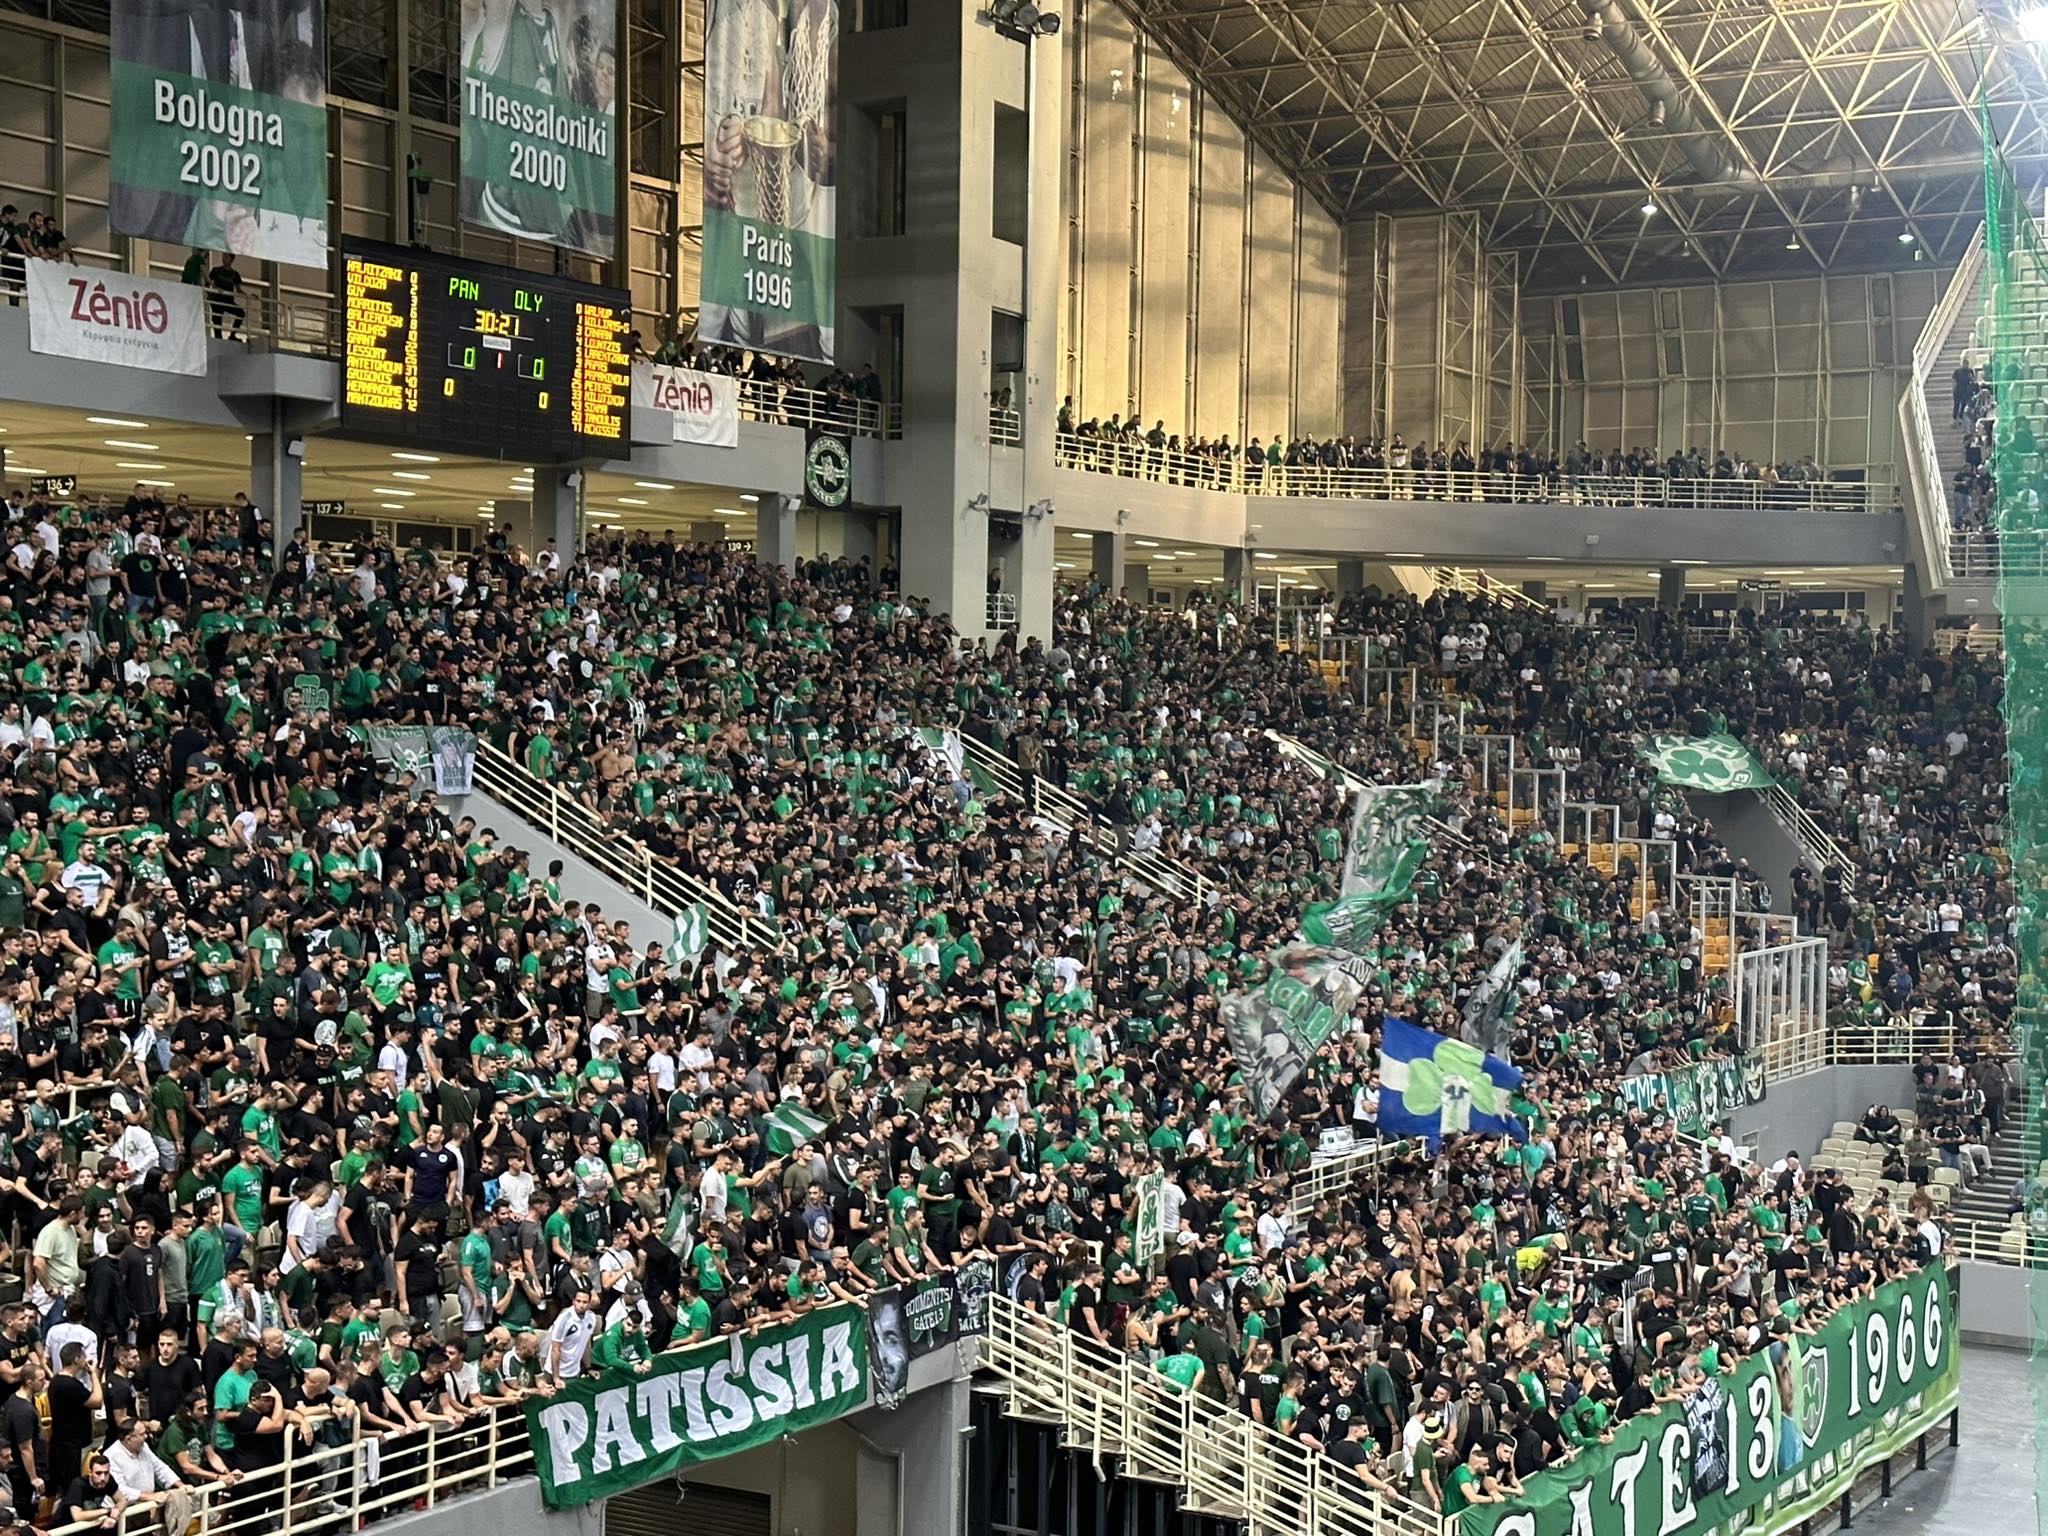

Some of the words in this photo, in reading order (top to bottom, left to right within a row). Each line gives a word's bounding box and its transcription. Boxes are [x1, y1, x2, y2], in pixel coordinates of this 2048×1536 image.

[155, 78, 283, 147] Bologna
[465, 76, 607, 157] Thessaloniki
[180, 140, 261, 195] 2002
[509, 140, 567, 192] 2000
[743, 224, 793, 268] Paris
[449, 277, 479, 300] PAN
[515, 290, 543, 313] OLY
[744, 268, 793, 310] 1996
[475, 309, 520, 337] 30:21
[464, 347, 475, 368] 0
[498, 352, 502, 369] 1
[533, 358, 543, 378] 0
[444, 378, 454, 397] 0
[539, 391, 549, 409] 0
[47, 479, 63, 491] 136
[316, 503, 331, 514] 137
[1847, 1280, 1943, 1417] 1966
[538, 1321, 860, 1487] PATISSIA
[1494, 1419, 1697, 1536] ATE
[1725, 1374, 1774, 1496] 13
